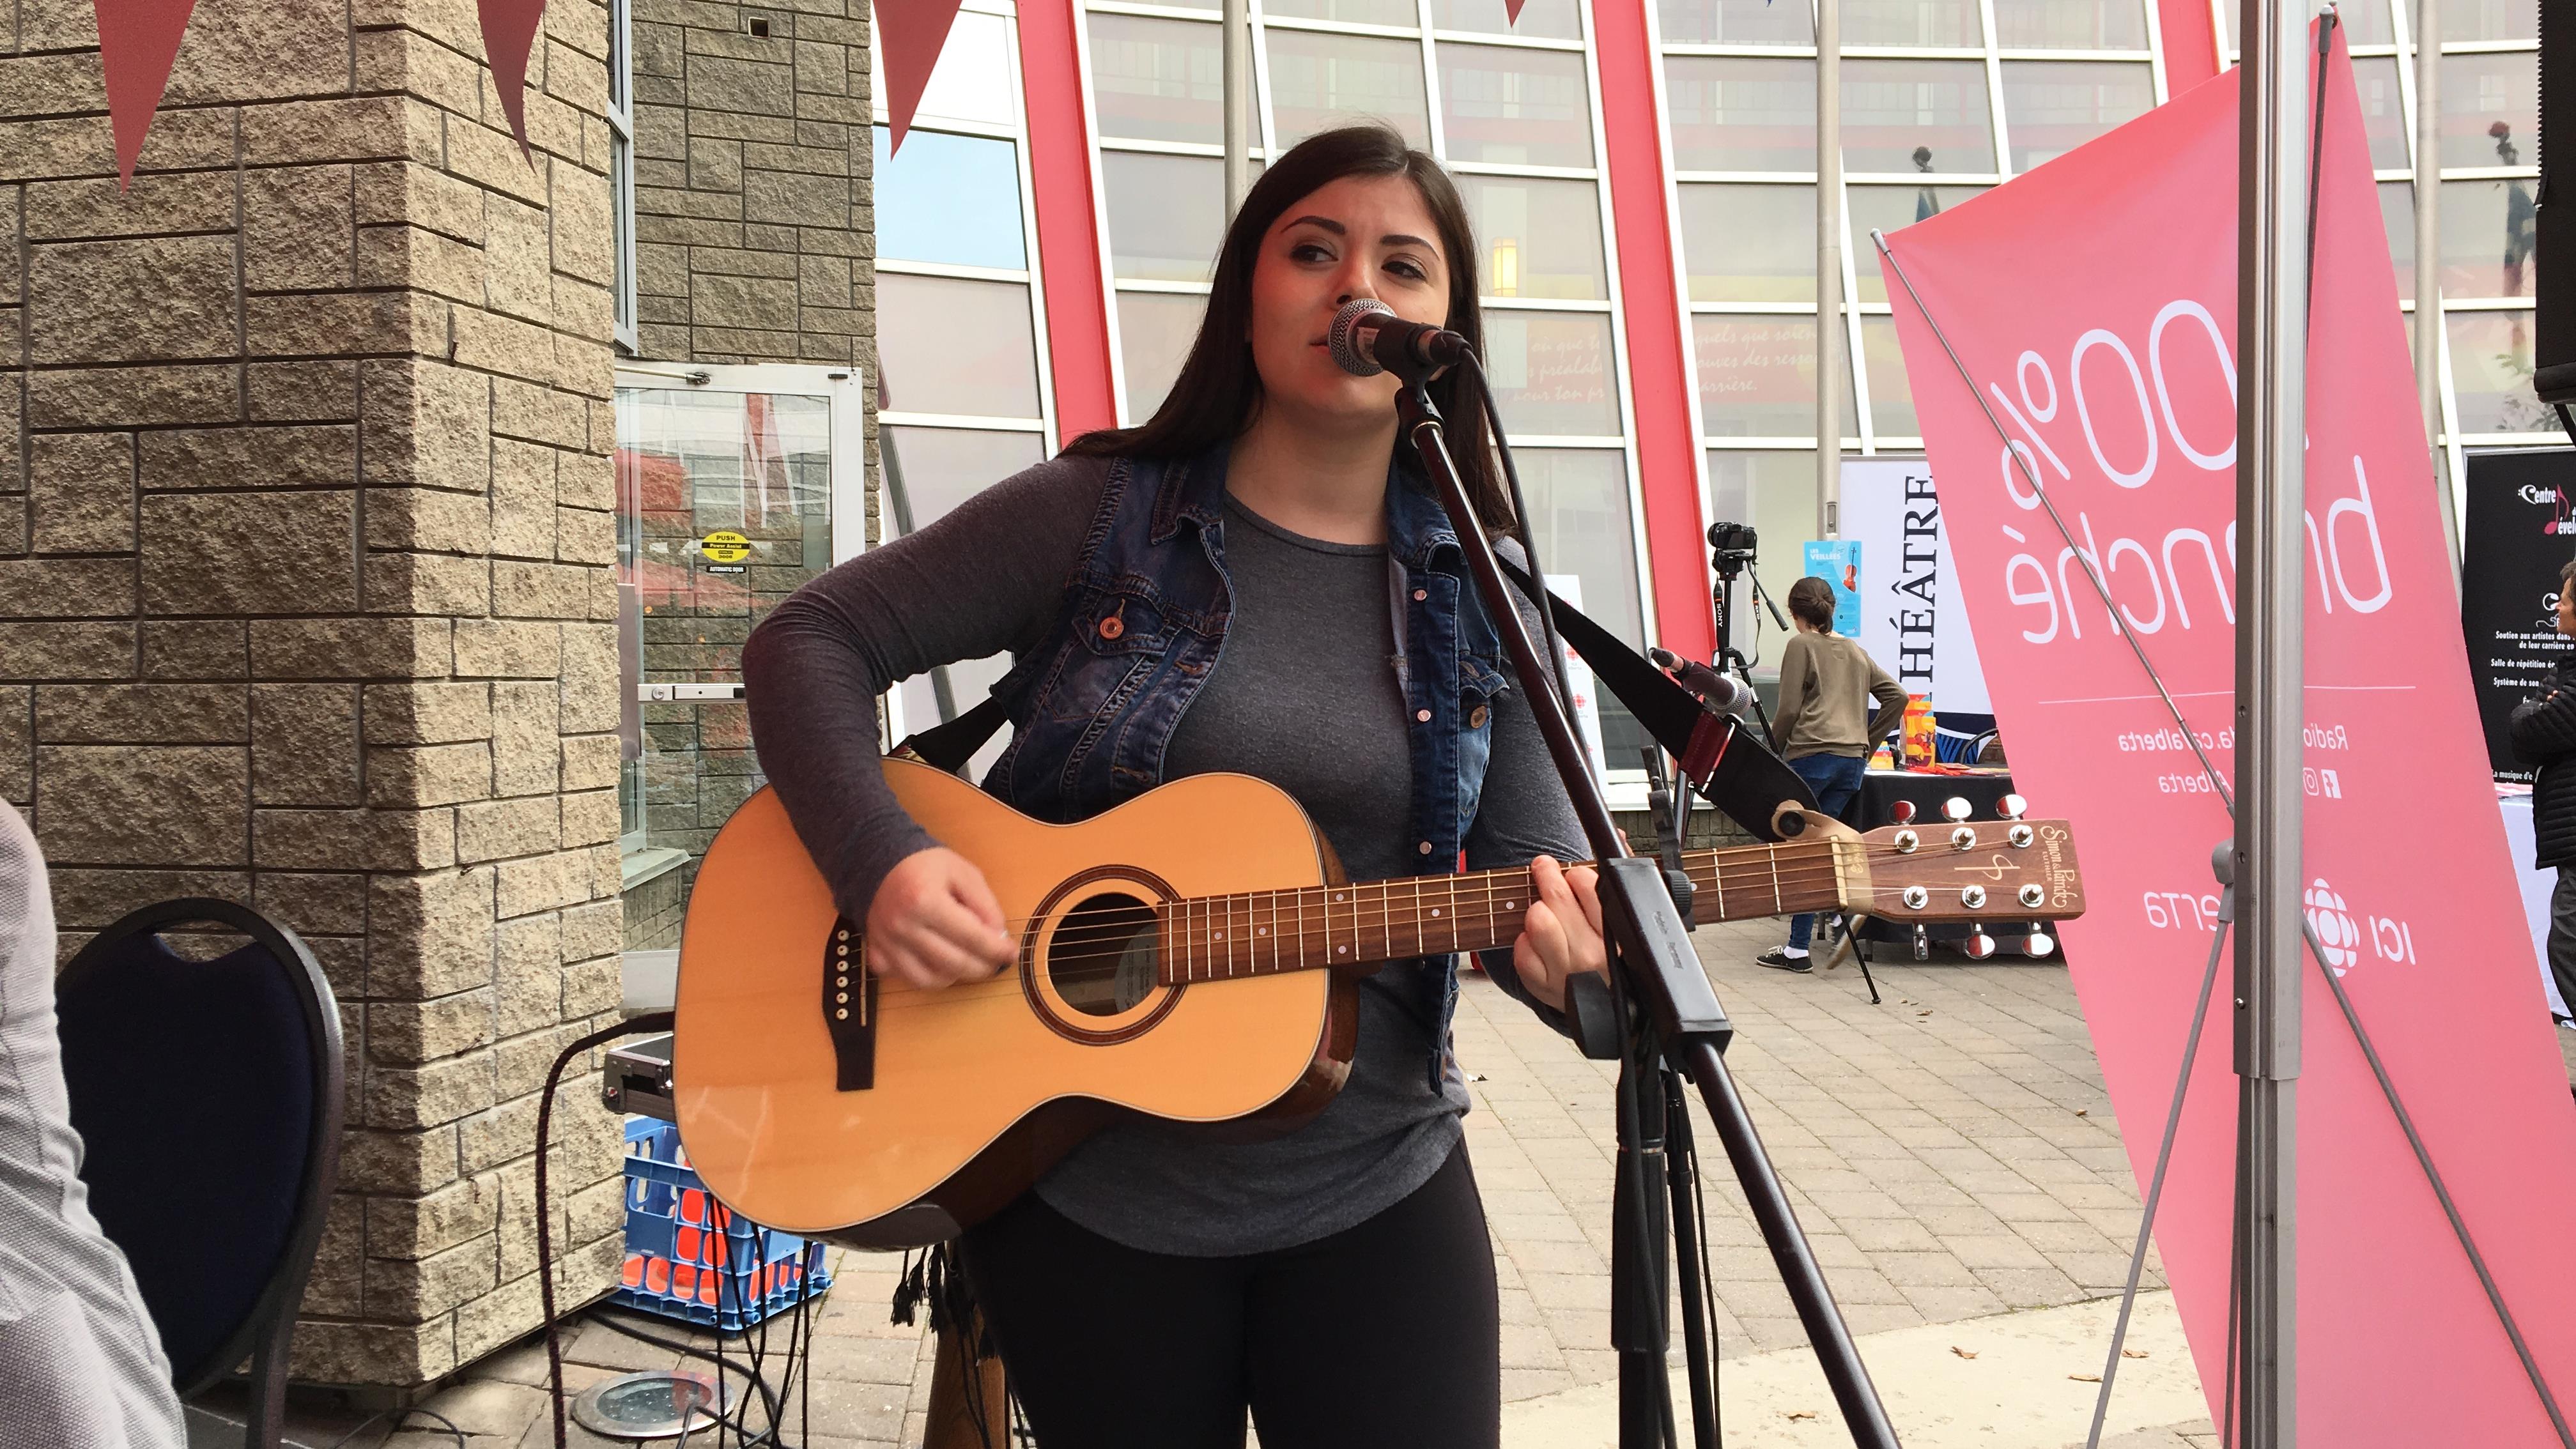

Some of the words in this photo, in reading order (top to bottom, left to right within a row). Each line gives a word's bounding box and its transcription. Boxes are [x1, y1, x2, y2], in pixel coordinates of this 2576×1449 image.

[2518, 484, 2556, 505] Centre
[1889, 475, 1939, 702] HÉÂTRE
[2495, 631, 2518, 640] Soutien
[2532, 631, 2555, 640] artistes
[2519, 641, 2527, 649] de
[2528, 641, 2540, 649] leur
[2541, 641, 2565, 650] carrière
[2490, 658, 2506, 667] Salle
[2507, 659, 2515, 668] de
[2517, 659, 2546, 670] répétition
[2494, 677, 2518, 687] Système
[2520, 678, 2527, 687] de
[2499, 769, 2523, 781] musique
[2039, 825, 2067, 862] Simon
[2051, 869, 2078, 908] Patrick
